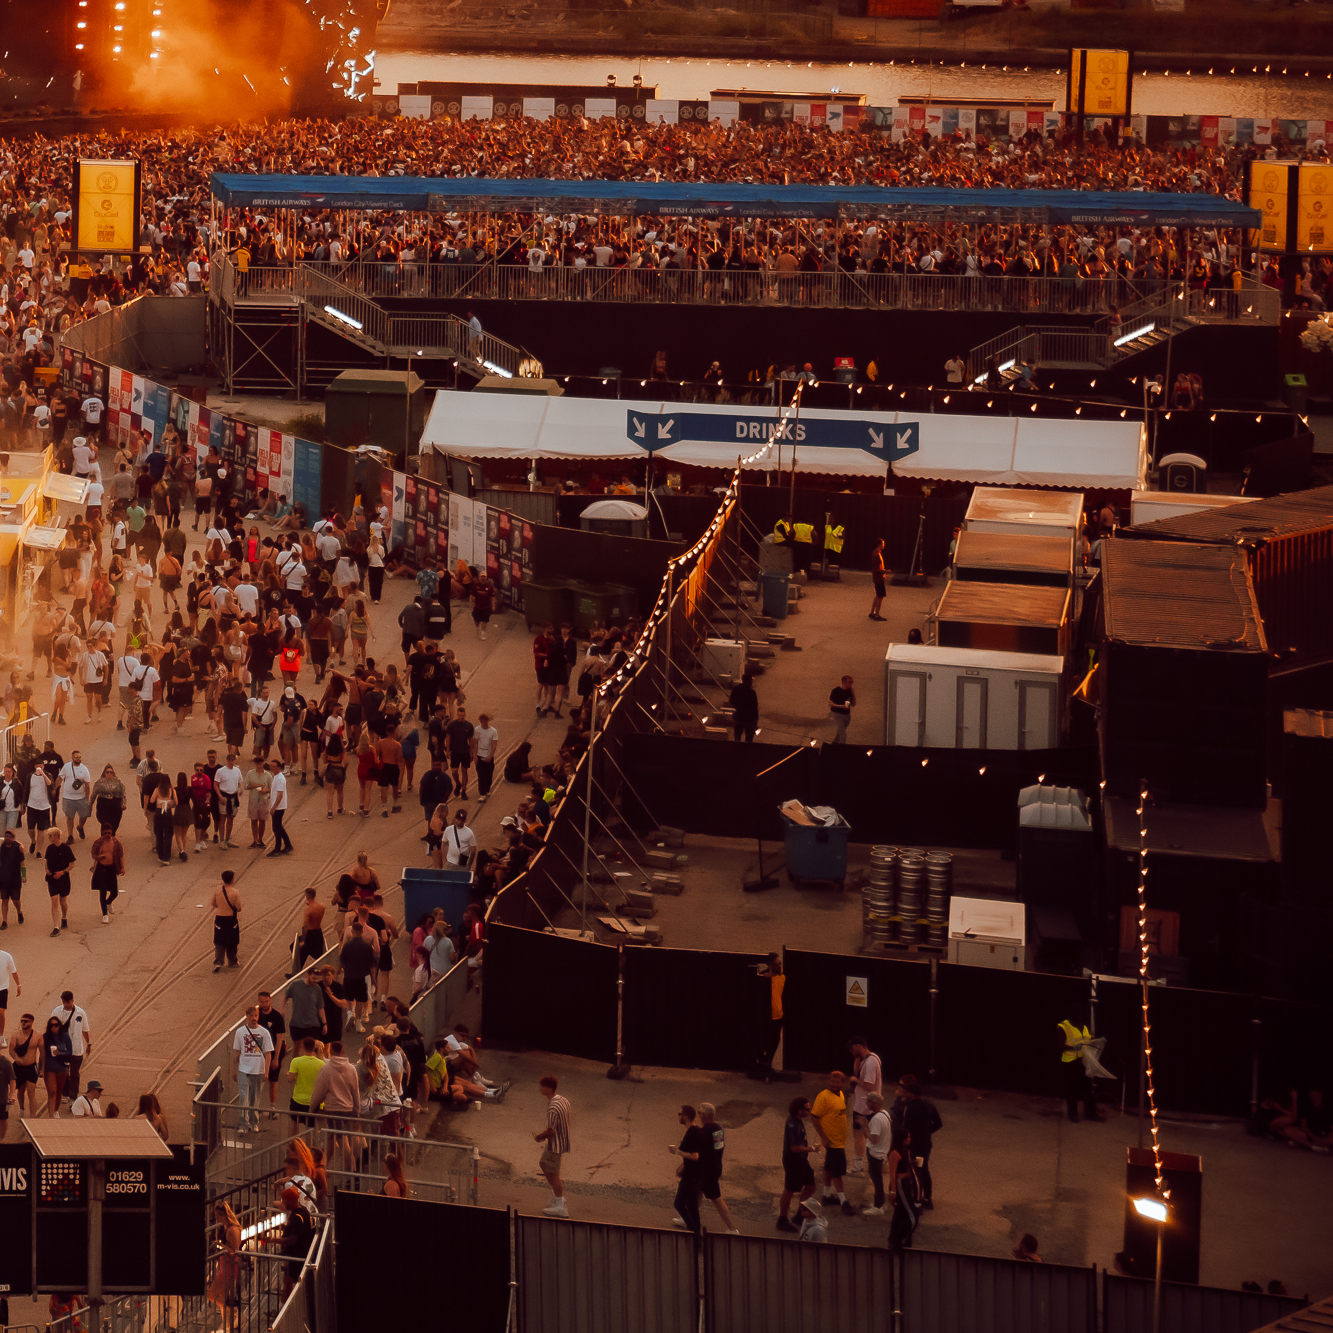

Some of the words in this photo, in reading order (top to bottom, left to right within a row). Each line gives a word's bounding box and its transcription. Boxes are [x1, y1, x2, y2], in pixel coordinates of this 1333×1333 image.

[366, 201, 388, 209] Viewing
[735, 421, 806, 441] DRINKS
[109, 1171, 143, 1182] 01629
[106, 1183, 147, 1194] 580570
